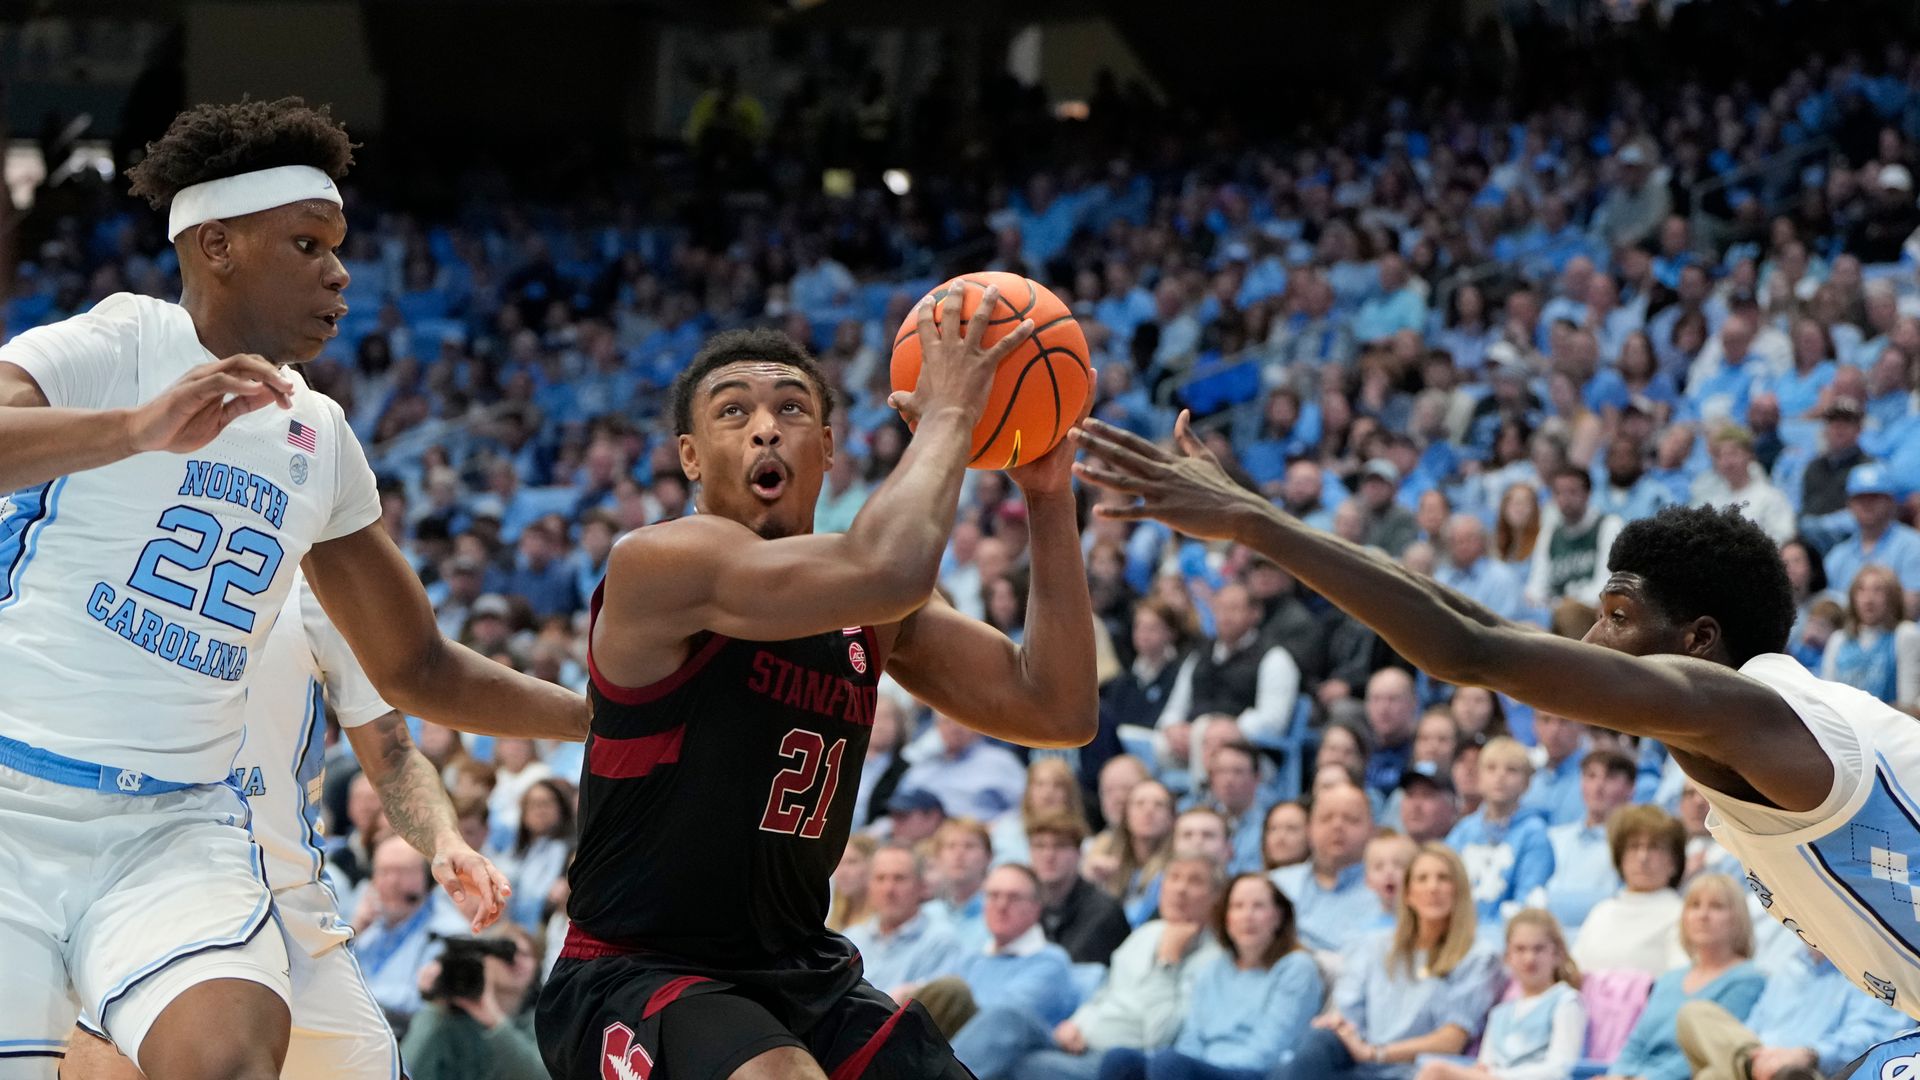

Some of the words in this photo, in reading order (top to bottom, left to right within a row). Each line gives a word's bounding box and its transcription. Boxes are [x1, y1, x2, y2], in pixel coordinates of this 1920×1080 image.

[178, 460, 289, 529] NORTH
[126, 504, 285, 634] 22
[86, 581, 248, 682] CAROLINA
[758, 727, 847, 839] 21
